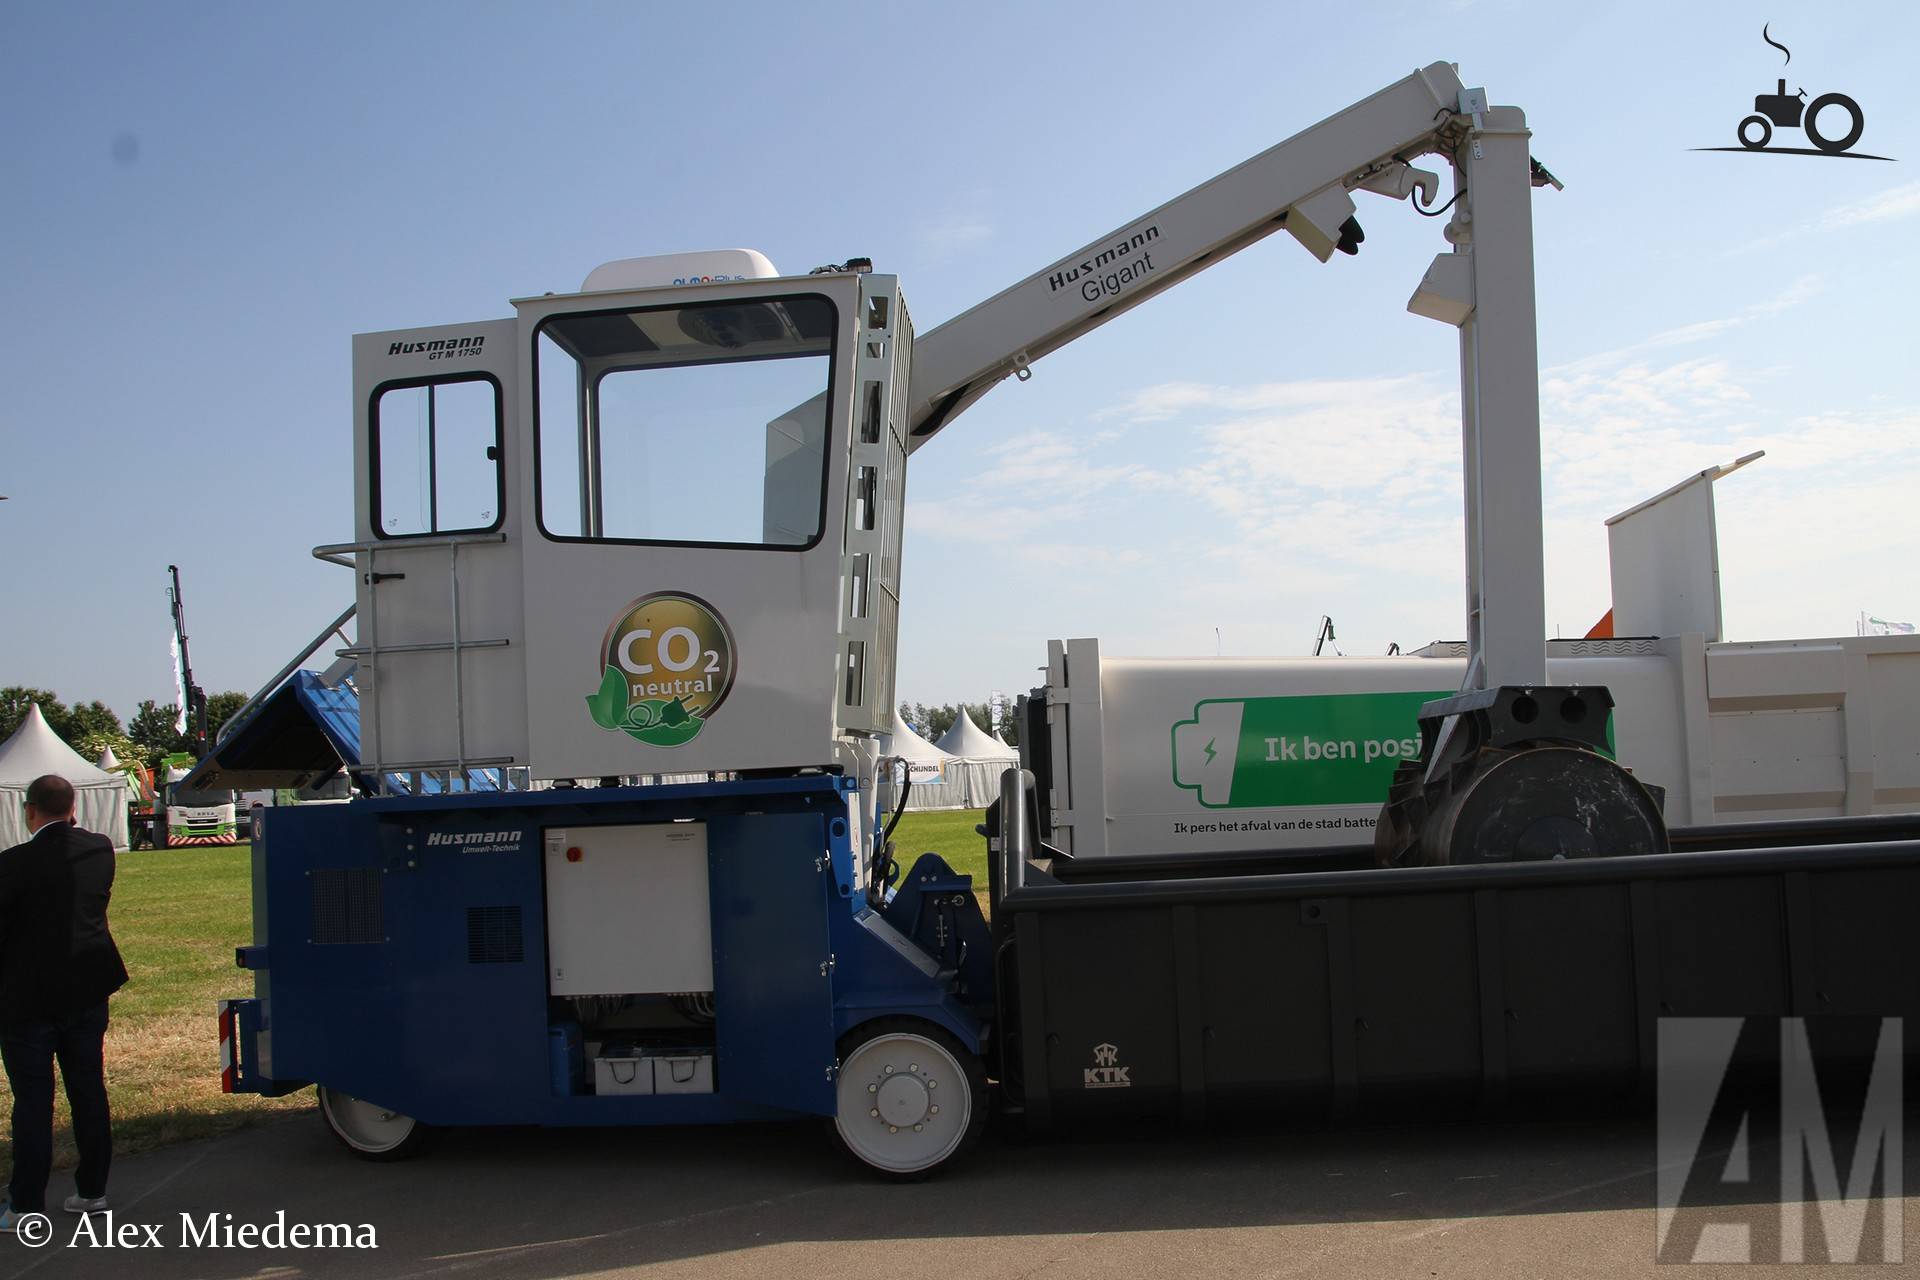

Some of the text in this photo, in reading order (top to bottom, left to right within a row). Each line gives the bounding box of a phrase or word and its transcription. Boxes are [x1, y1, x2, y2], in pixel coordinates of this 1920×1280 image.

[1049, 225, 1159, 292] Husmann
[1081, 251, 1154, 302] Gigant
[388, 336, 485, 355] Husmann
[428, 347, 482, 361] GT M 1750
[632, 674, 713, 697] neutral
[1264, 737, 1298, 762] Ik
[1304, 735, 1357, 761] ben
[908, 765, 939, 773] CHIJNDEL
[1174, 817, 1380, 835] Ik pers het afval van de stad batte
[426, 830, 523, 846] Husmann
[462, 843, 521, 854] Umwelt-Technik
[1084, 1066, 1130, 1083] KTK
